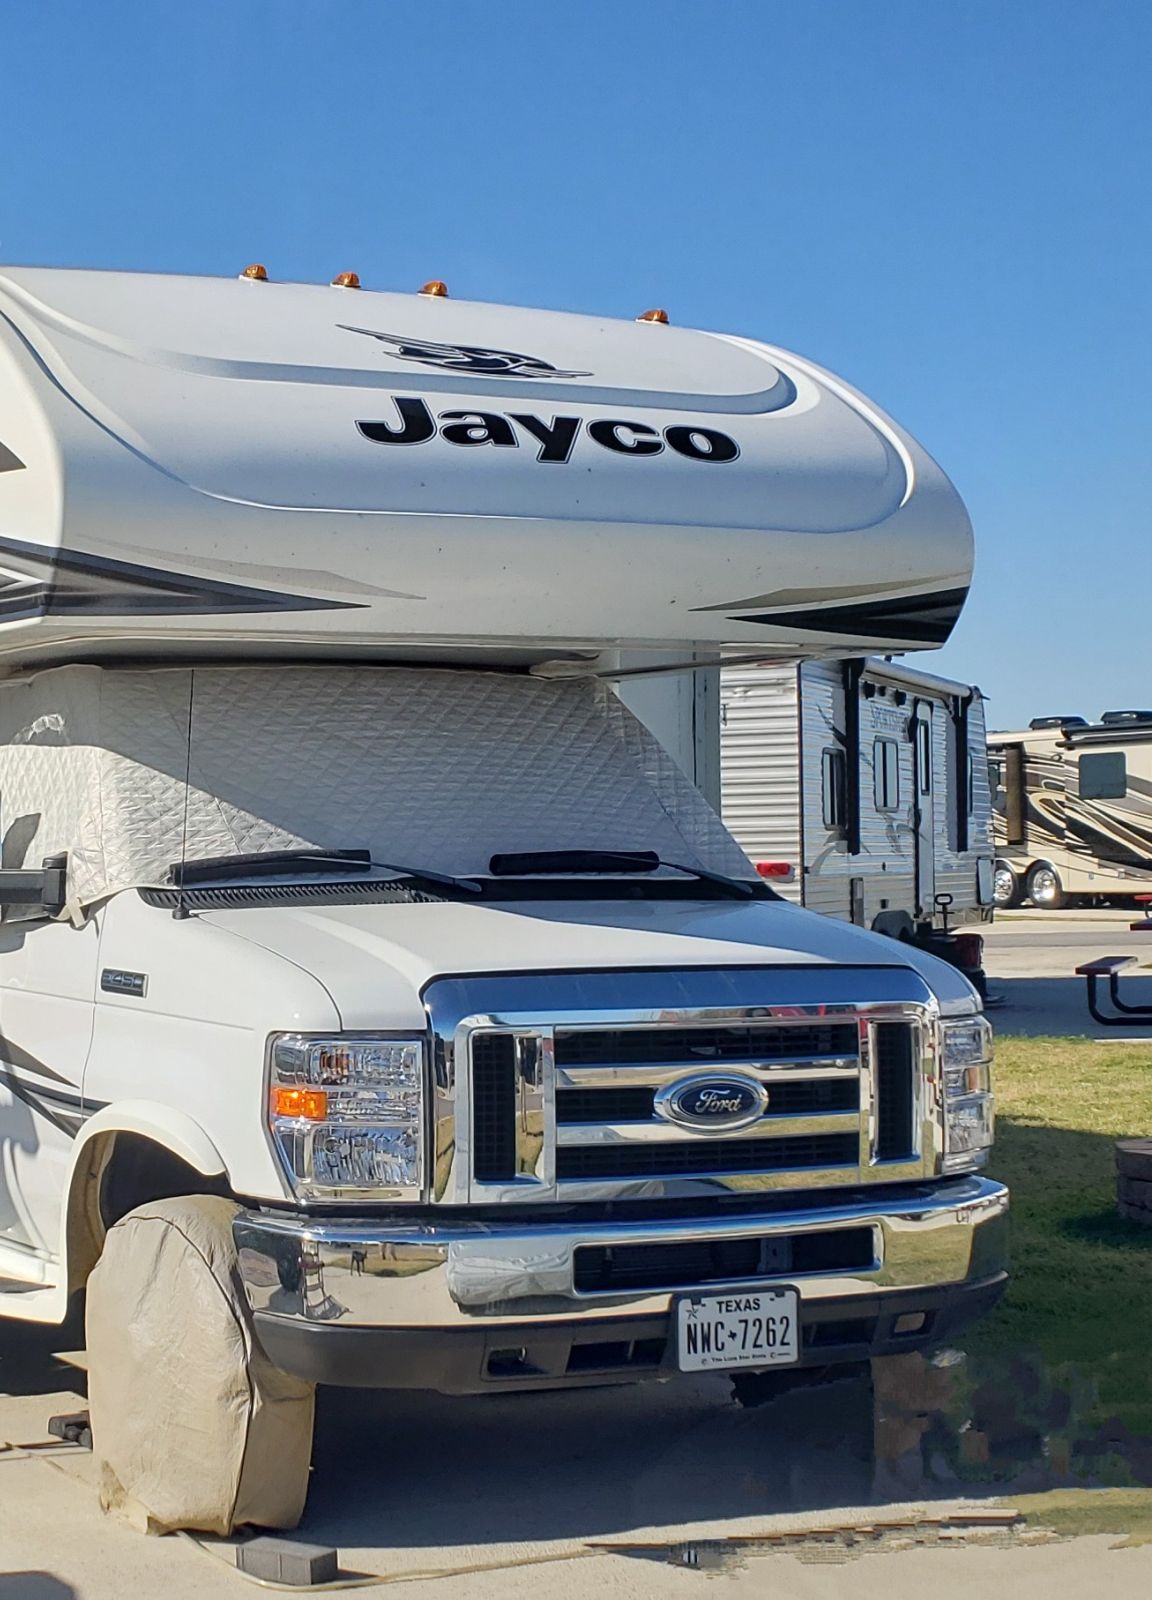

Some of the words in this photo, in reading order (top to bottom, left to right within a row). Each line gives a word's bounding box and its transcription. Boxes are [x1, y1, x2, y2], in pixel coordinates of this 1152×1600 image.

[355, 396, 741, 464] Jayco
[695, 1089, 742, 1113] Ford
[716, 1298, 761, 1314] TEXAS
[686, 1321, 725, 1355] NWC
[738, 1316, 791, 1350] 7262
